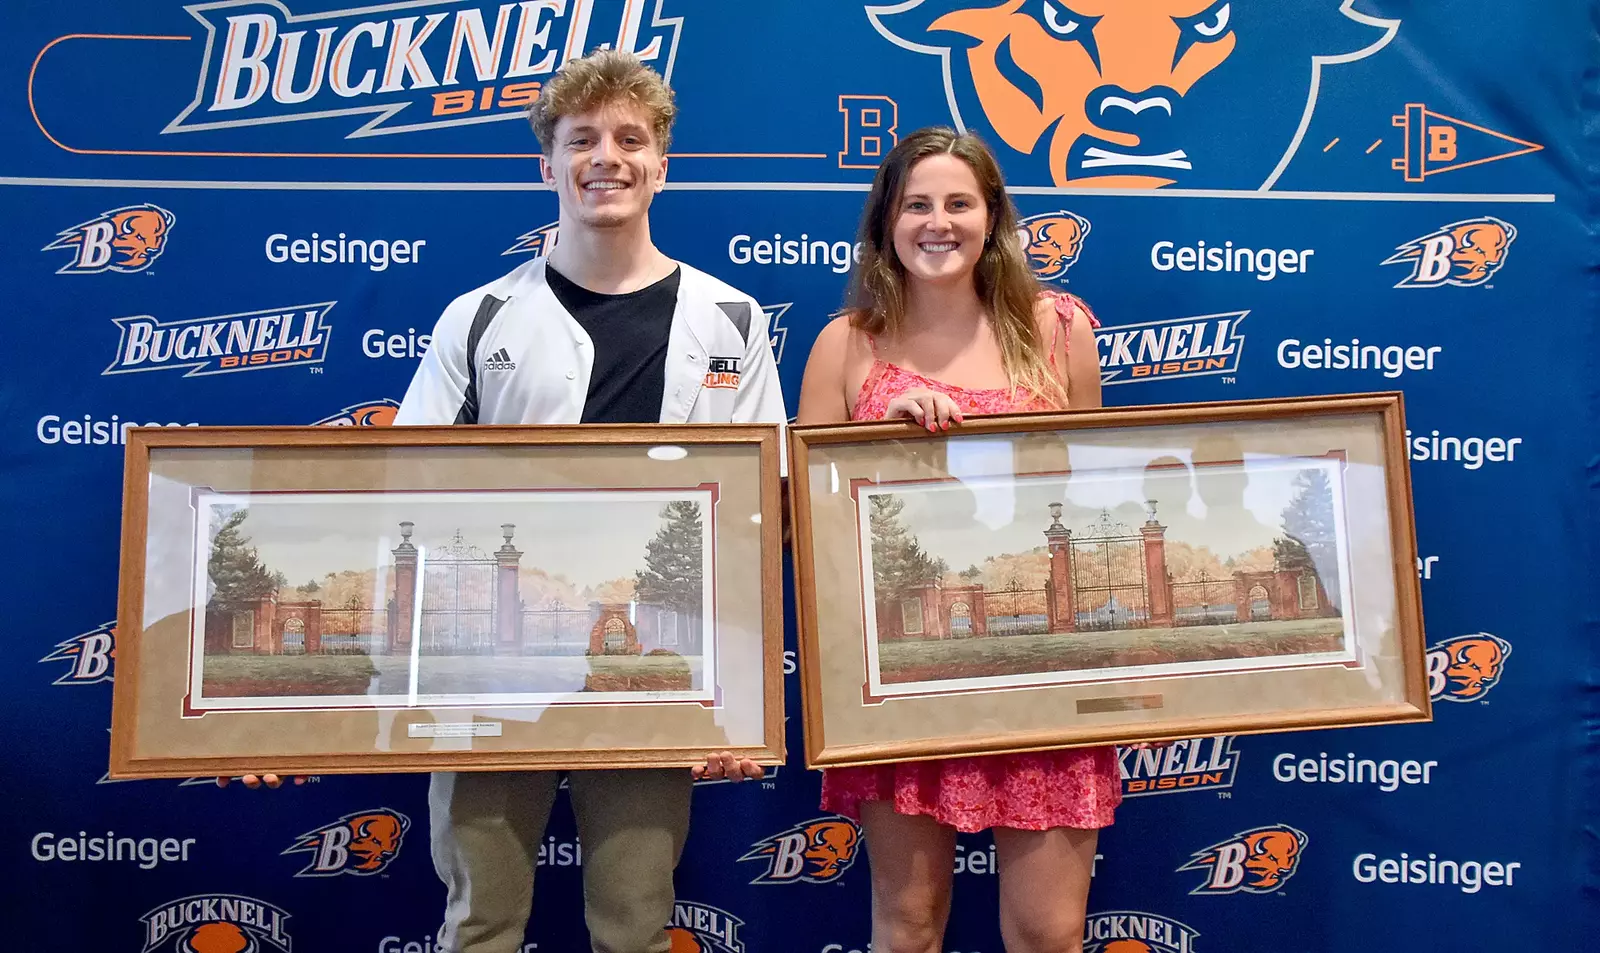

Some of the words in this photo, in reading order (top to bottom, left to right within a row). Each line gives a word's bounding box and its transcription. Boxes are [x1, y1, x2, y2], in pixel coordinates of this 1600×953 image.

[208, 0, 663, 111] BUCKNELL
[432, 82, 541, 116] BIS
[838, 95, 898, 169] B
[1428, 126, 1457, 162] B
[77, 221, 114, 268] B
[265, 233, 426, 271] Geisinger
[728, 233, 865, 274] Geising
[1151, 240, 1315, 281] Geisinger
[1414, 235, 1454, 282] B
[122, 310, 323, 366] BUCKNELL
[220, 347, 315, 368] BISON
[1095, 319, 1236, 367] CKNELL
[1277, 338, 1442, 378] Geisinger
[309, 367, 324, 375] TM
[1132, 356, 1228, 377] BISON
[1221, 376, 1236, 384] TM
[1406, 430, 1523, 470] isinger
[73, 633, 112, 678] B
[1117, 736, 1231, 780] KNELL
[1273, 752, 1438, 792] Geisinger
[761, 782, 776, 790] TM
[1127, 772, 1223, 792] BISON
[31, 831, 196, 870] Geisinger
[314, 825, 351, 871] B
[769, 833, 807, 878] B
[1208, 842, 1247, 889] B
[1353, 852, 1521, 893] Geisinger
[150, 898, 288, 947] BUCKNELL
[674, 904, 740, 953] NELL
